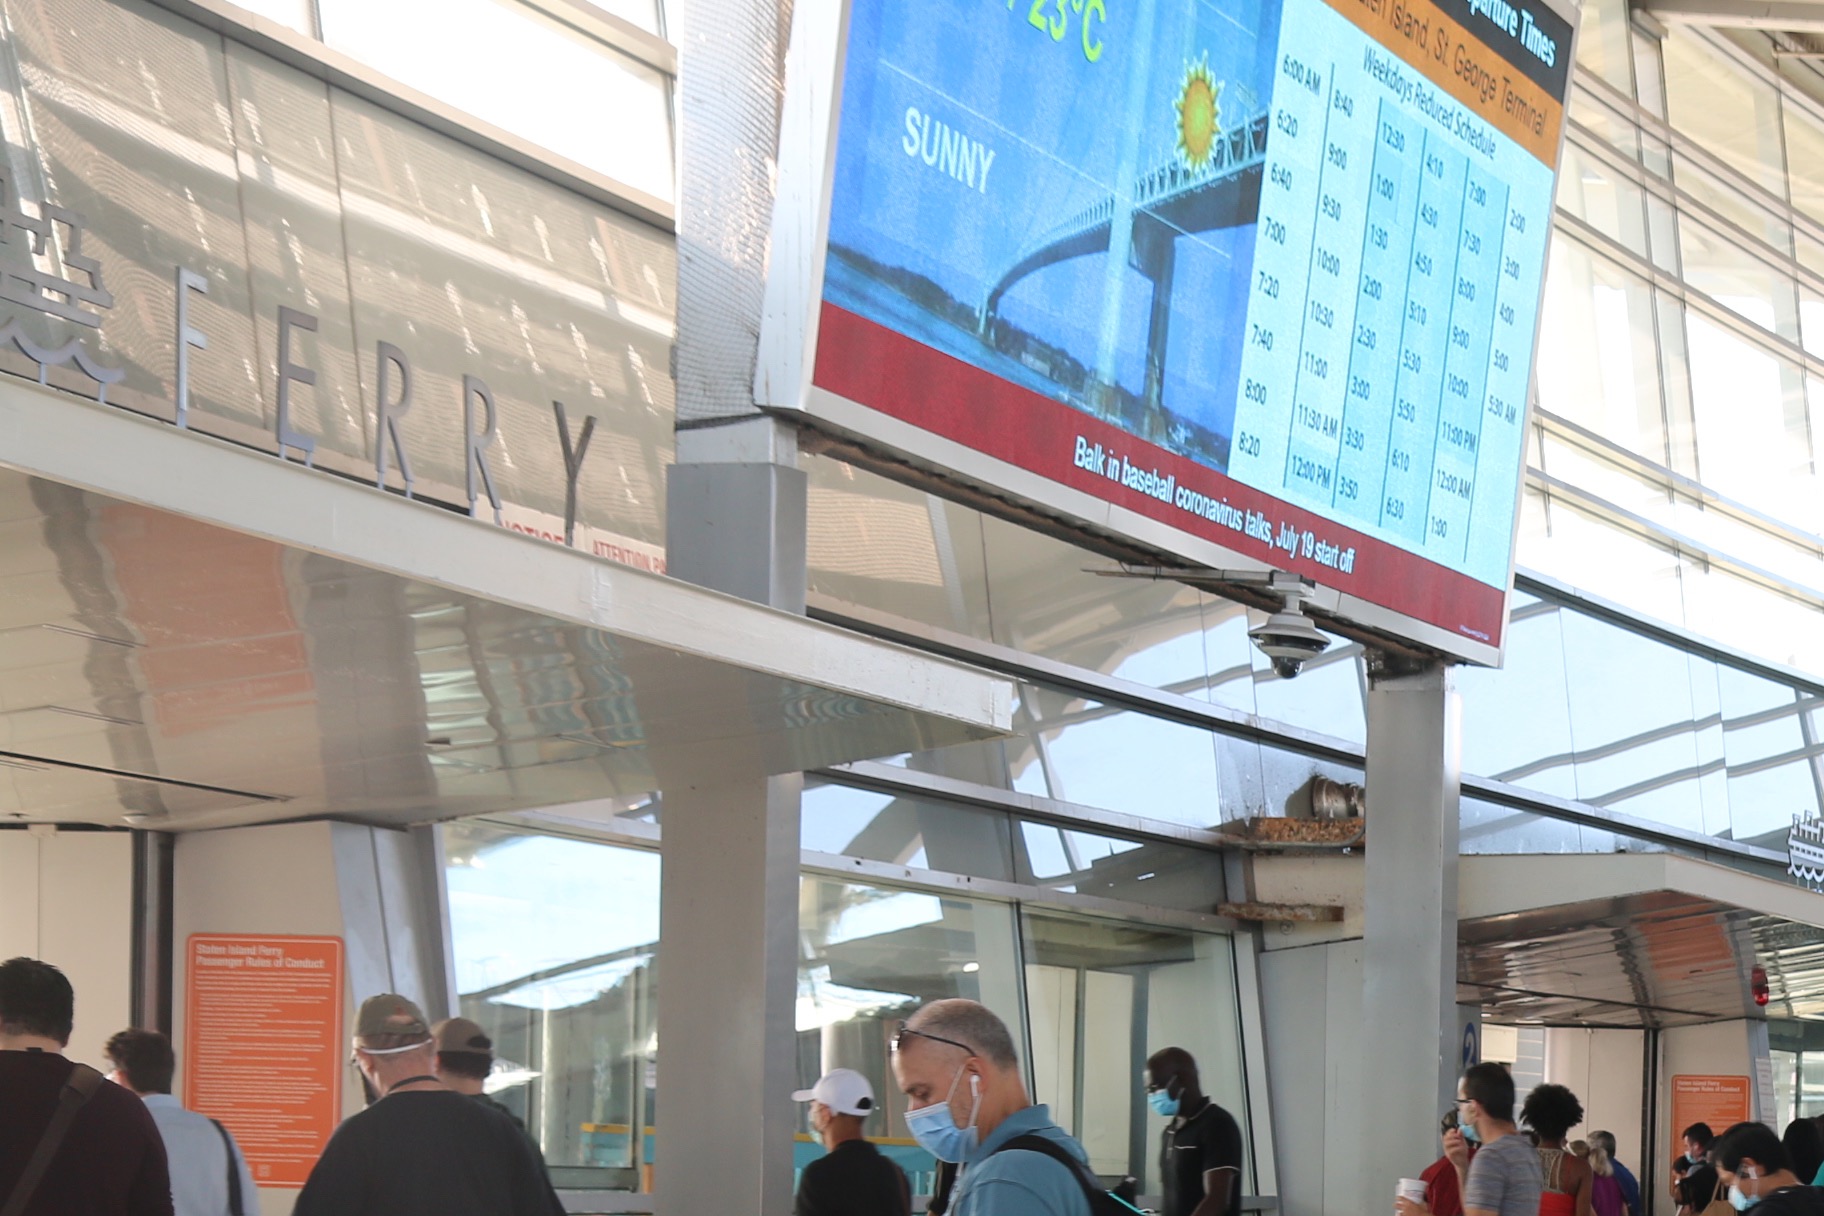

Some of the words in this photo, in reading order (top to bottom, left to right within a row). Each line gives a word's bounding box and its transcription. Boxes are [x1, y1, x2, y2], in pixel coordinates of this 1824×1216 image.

[1468, 0, 1519, 38] parture
[1520, 9, 1557, 68] Times
[1283, 54, 1304, 86] 6:00
[1305, 70, 1321, 96] AM
[1389, 0, 1430, 56] Island,
[1454, 44, 1497, 104] George
[1502, 76, 1548, 137] Terminal
[1334, 89, 1353, 118] 8:40
[1363, 44, 1413, 104] Weekdays
[1414, 81, 1455, 131] Reduced
[1454, 112, 1497, 160] Schedule
[1277, 109, 1298, 138] 6:20
[902, 106, 996, 195] SUNNY
[1381, 122, 1405, 153] 12:30
[1328, 143, 1347, 170] 9:00
[1427, 154, 1444, 179] 4:10
[1271, 163, 1292, 192] 6:40
[1376, 174, 1394, 201] 1:00
[1322, 194, 1341, 221] 9:30
[1469, 181, 1486, 207] 7:00
[1421, 204, 1439, 228] 4:30
[1510, 209, 1525, 234] 2:00
[1265, 217, 1286, 245] 7:00
[1370, 224, 1388, 250] 1:30
[1464, 229, 1481, 255] 7:30
[1317, 247, 1340, 277] 10:00
[1415, 252, 1432, 277] 4:50
[1504, 255, 1520, 281] 3:00
[1257, 271, 1279, 299] 7:20
[1363, 275, 1381, 300] 2:00
[1458, 277, 1475, 302] 8:00
[1311, 301, 1334, 329] 10:30
[1408, 301, 1427, 326] 5:10
[1499, 303, 1514, 326] 4:00
[1251, 324, 1273, 352] 7:40
[1357, 325, 1376, 350] 2:30
[1453, 327, 1470, 350] 9:00
[1304, 351, 1328, 379] 11:00
[1403, 350, 1421, 374] 5:30
[1494, 349, 1508, 373] 5:00
[1245, 378, 1266, 405] 8:00
[1351, 377, 1370, 400] 3:00
[1448, 373, 1469, 399] 10:00
[175, 265, 598, 540] FERRY
[1397, 399, 1415, 423] 5:50
[1488, 395, 1503, 419] 5:30
[1505, 405, 1516, 426] AM
[1298, 404, 1322, 433] 11:30
[1323, 418, 1337, 441] AM
[1239, 431, 1260, 458] 8:20
[1345, 427, 1364, 451] 3:30
[1442, 421, 1463, 448] 11:00
[1463, 431, 1476, 454] PM
[1292, 456, 1315, 482] 12:00
[1316, 467, 1330, 490] PM
[1392, 449, 1410, 472] 6:10
[1339, 476, 1358, 500] 3:50
[1437, 470, 1456, 494] 12:00
[1457, 476, 1471, 500] AM
[1073, 435, 1106, 477] Balk
[1107, 449, 1120, 482] in
[1121, 455, 1175, 504] baseball
[1175, 485, 1244, 532] coronavirus
[1244, 508, 1274, 549] talks,
[1275, 521, 1299, 559] July
[1301, 530, 1315, 559] 19
[1314, 539, 1340, 569] start
[1339, 547, 1356, 574] off
[1387, 498, 1404, 520] 6:30
[1431, 516, 1447, 538] 1:00
